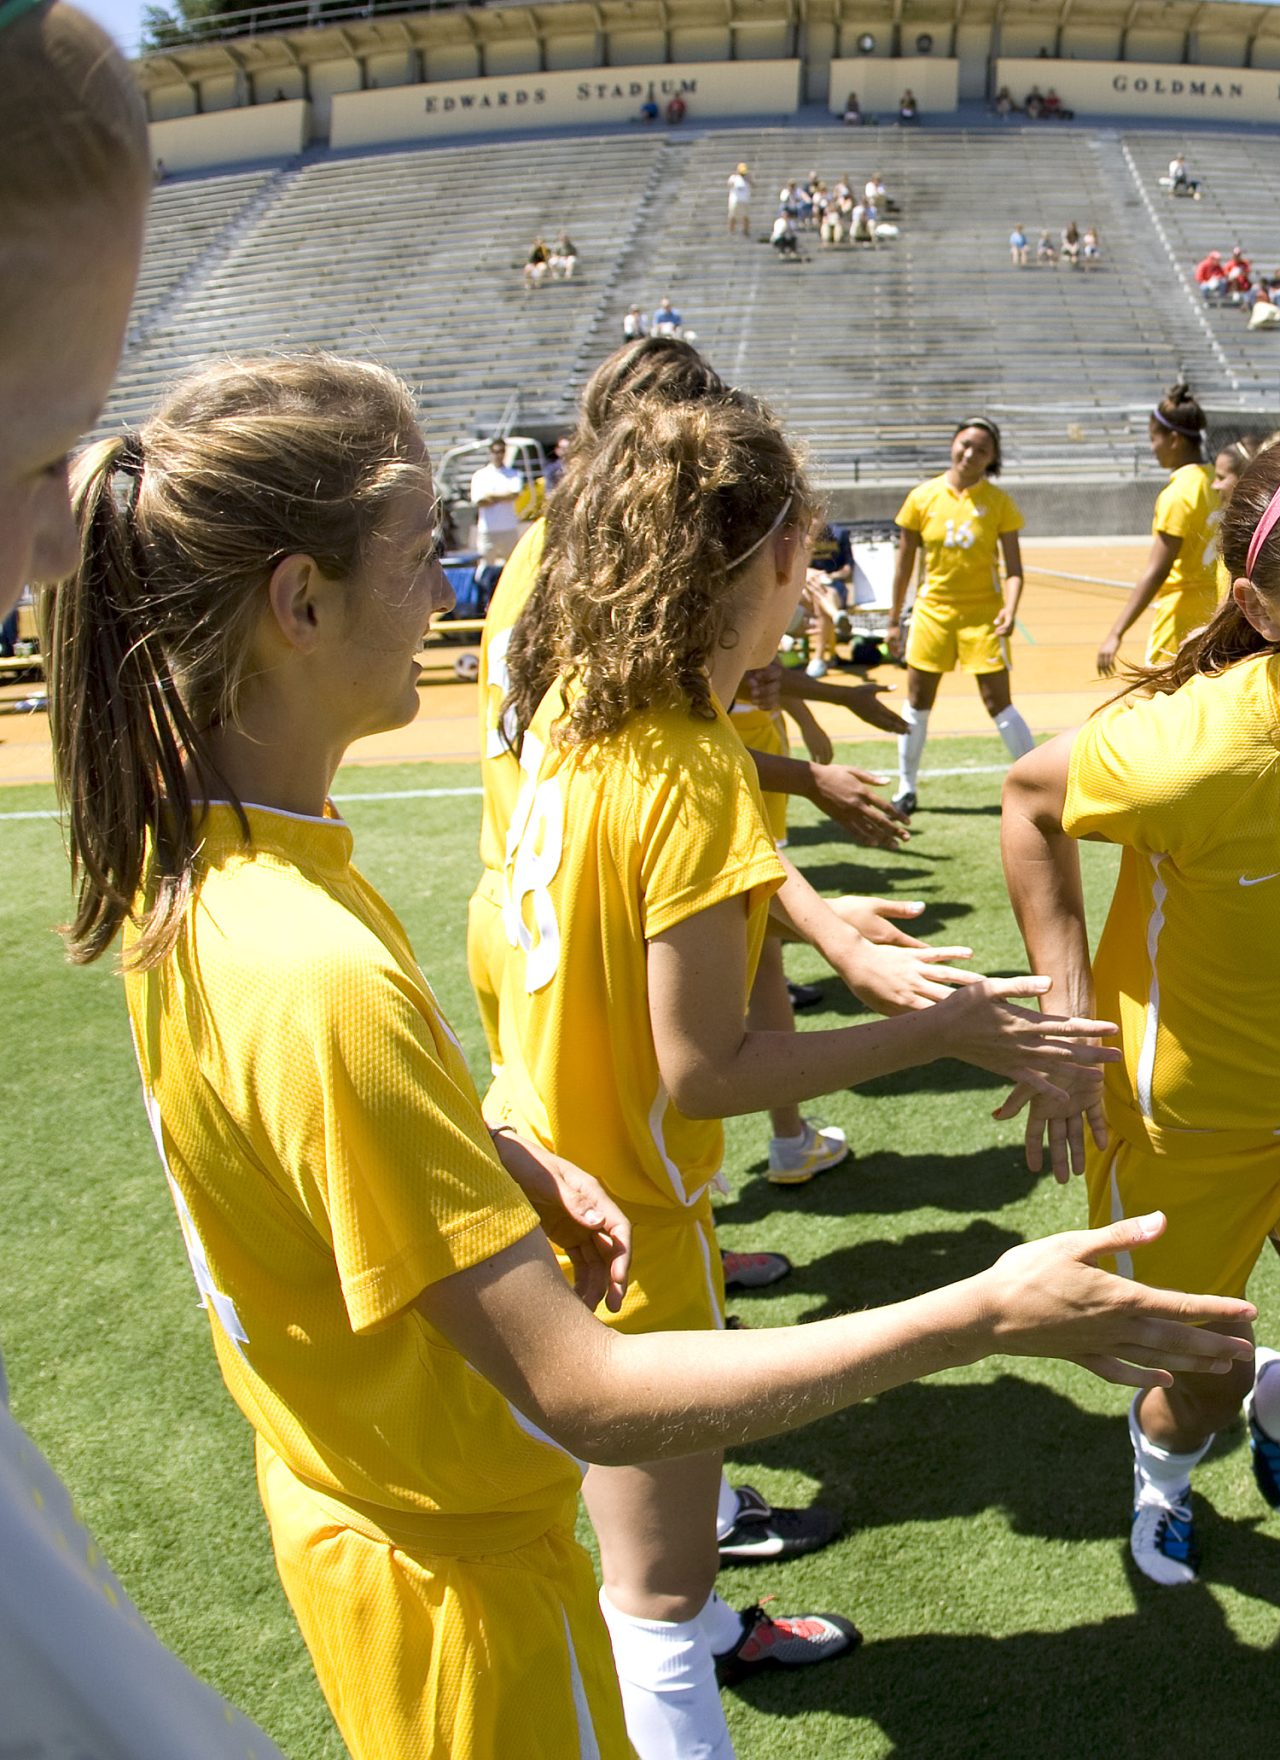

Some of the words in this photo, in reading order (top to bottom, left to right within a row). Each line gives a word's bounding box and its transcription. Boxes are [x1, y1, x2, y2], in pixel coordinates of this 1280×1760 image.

[425, 88, 547, 114] EDWARDS
[577, 79, 698, 100] STADIUM
[1112, 75, 1244, 98] GOLDMAN
[943, 519, 975, 549] 16
